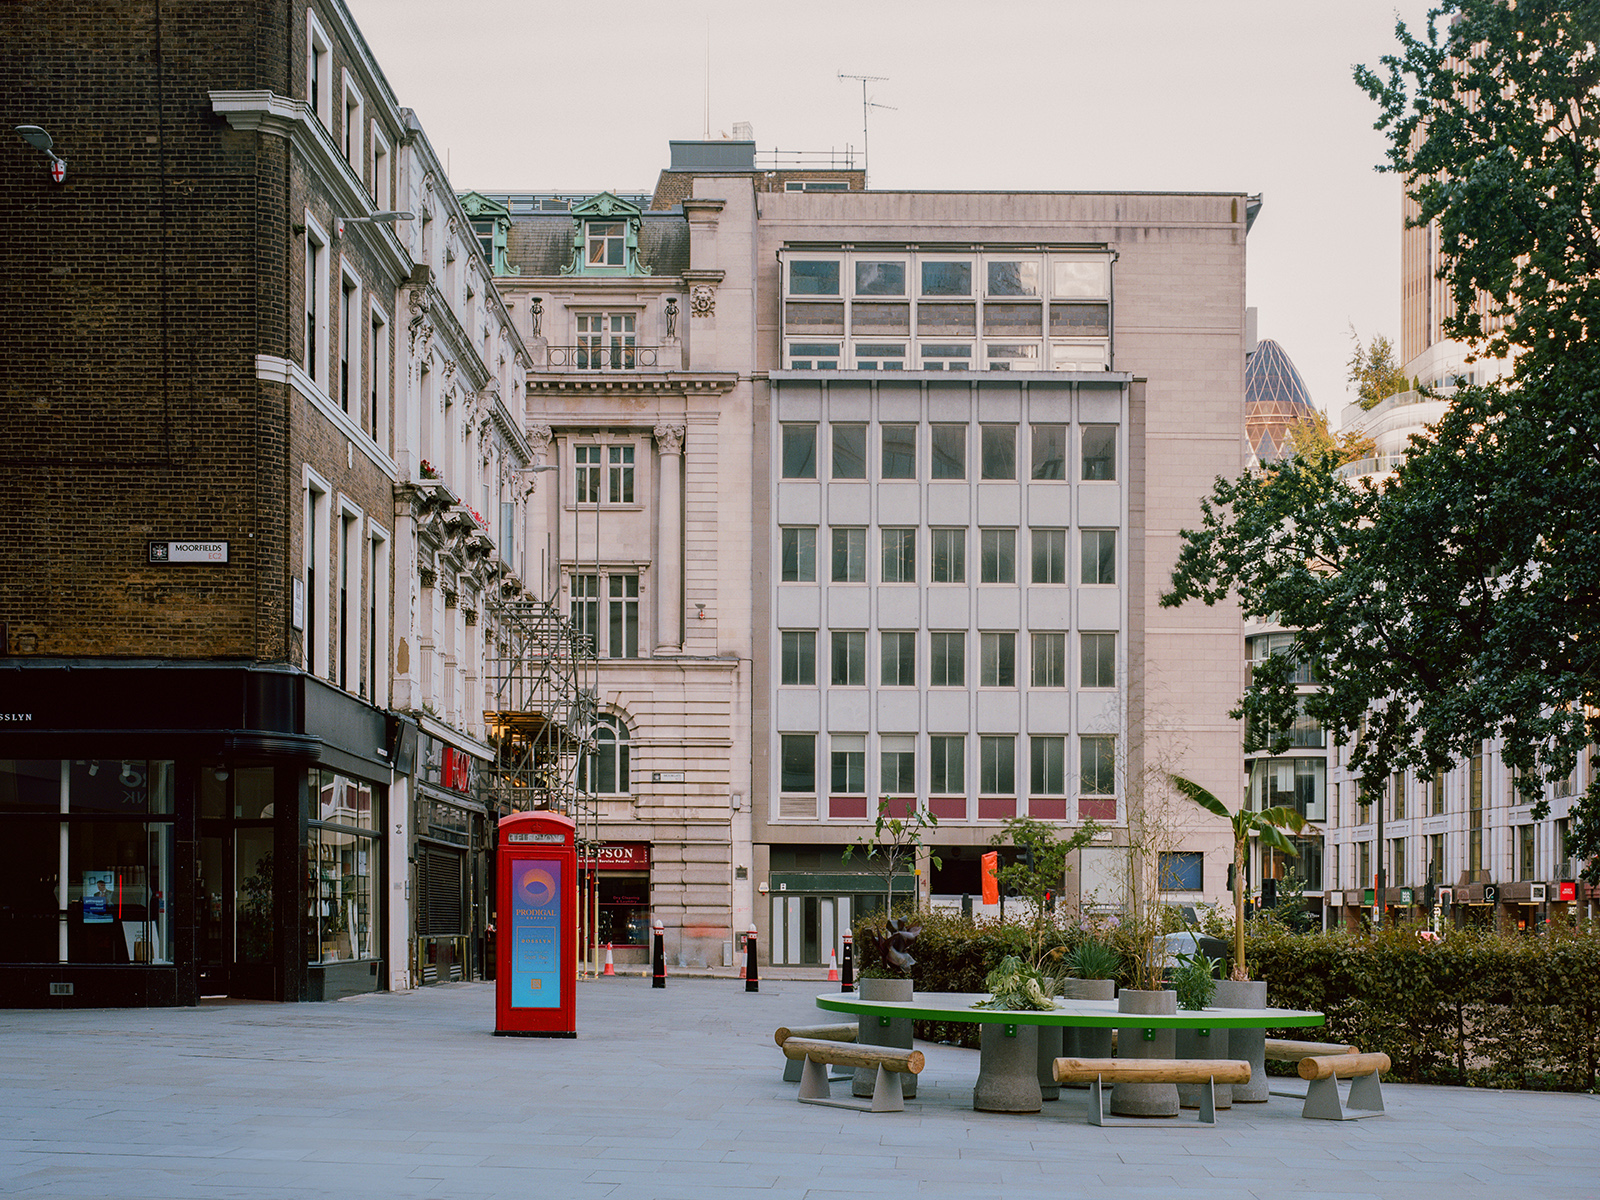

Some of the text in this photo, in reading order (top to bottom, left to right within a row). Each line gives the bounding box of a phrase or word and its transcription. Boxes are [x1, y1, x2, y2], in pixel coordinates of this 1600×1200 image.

[175, 544, 222, 552] MOORFIELDS
[208, 552, 222, 560] EC2
[516, 908, 557, 917] PRODIGAL
